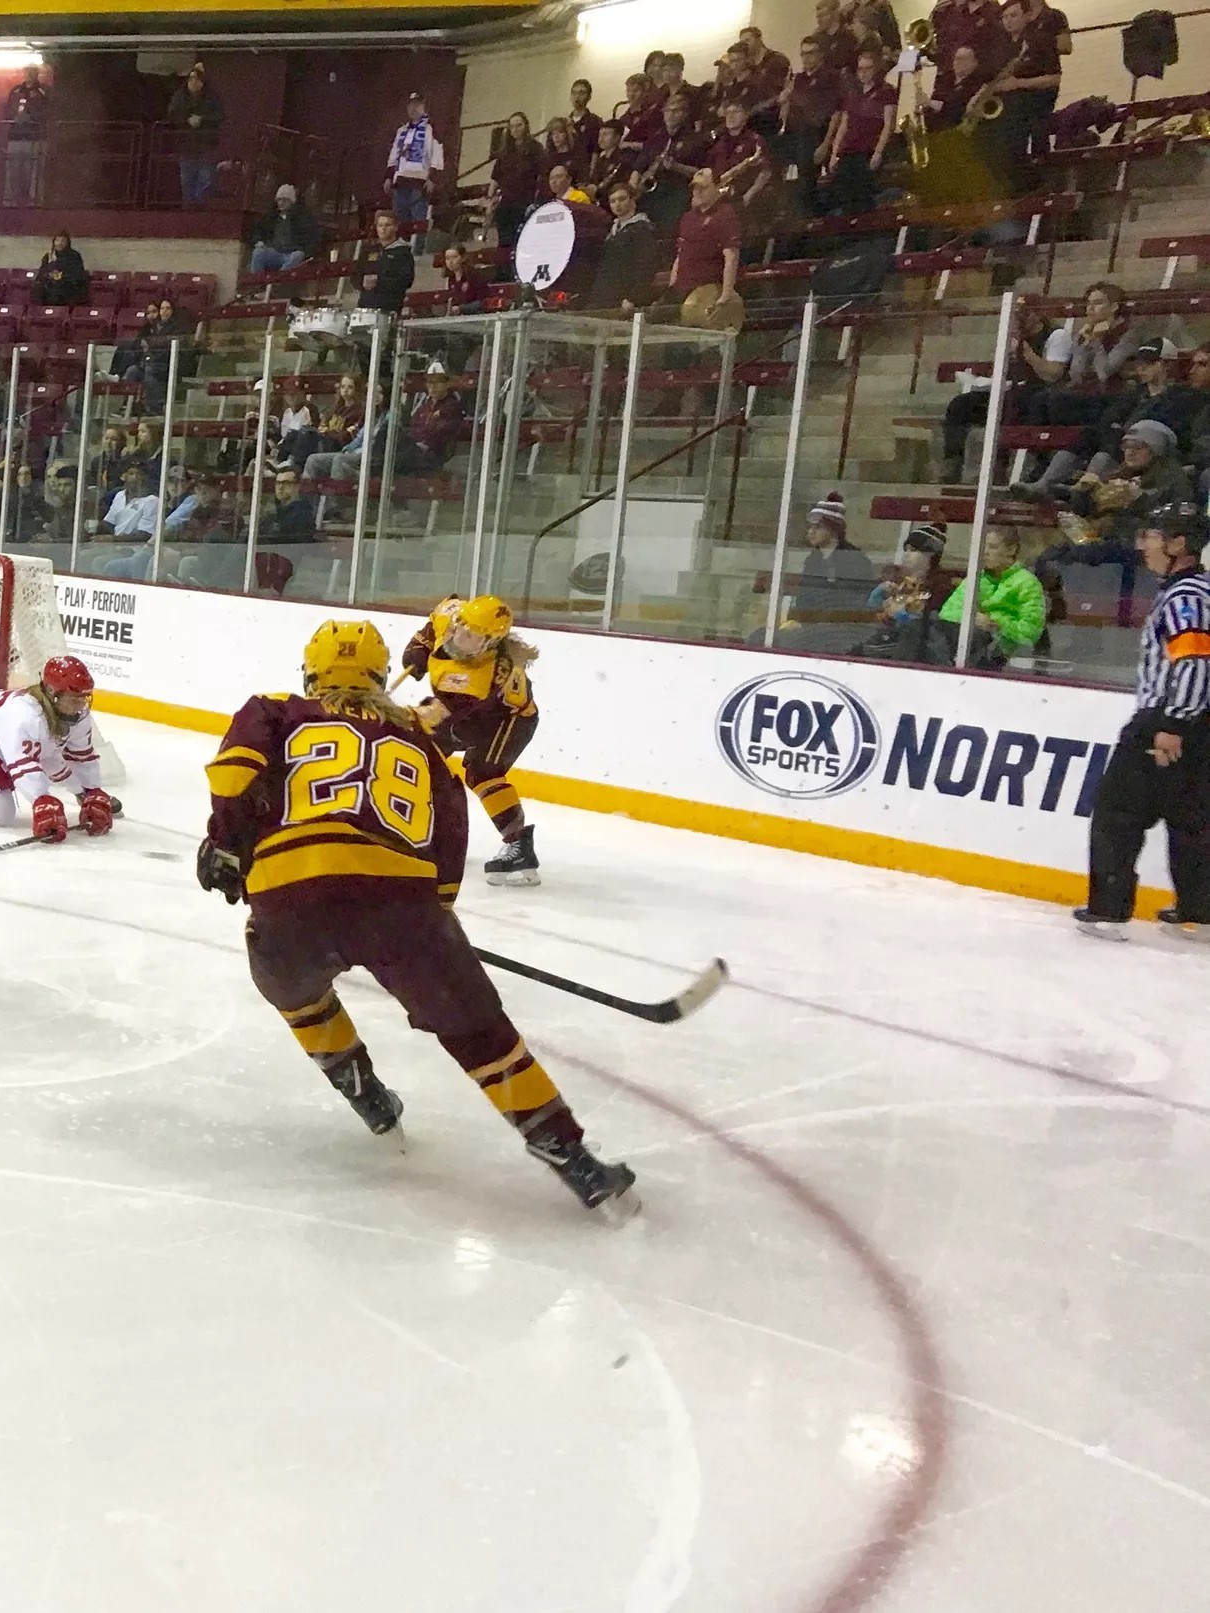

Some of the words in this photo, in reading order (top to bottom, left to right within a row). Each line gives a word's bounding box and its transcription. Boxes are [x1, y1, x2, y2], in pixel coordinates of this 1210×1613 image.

[64, 586, 87, 608] PLAY
[91, 590, 136, 615] PERFORM
[339, 641, 357, 657] 28
[750, 693, 845, 756] FOX
[746, 744, 841, 778] SPORTS
[281, 721, 435, 849] 28
